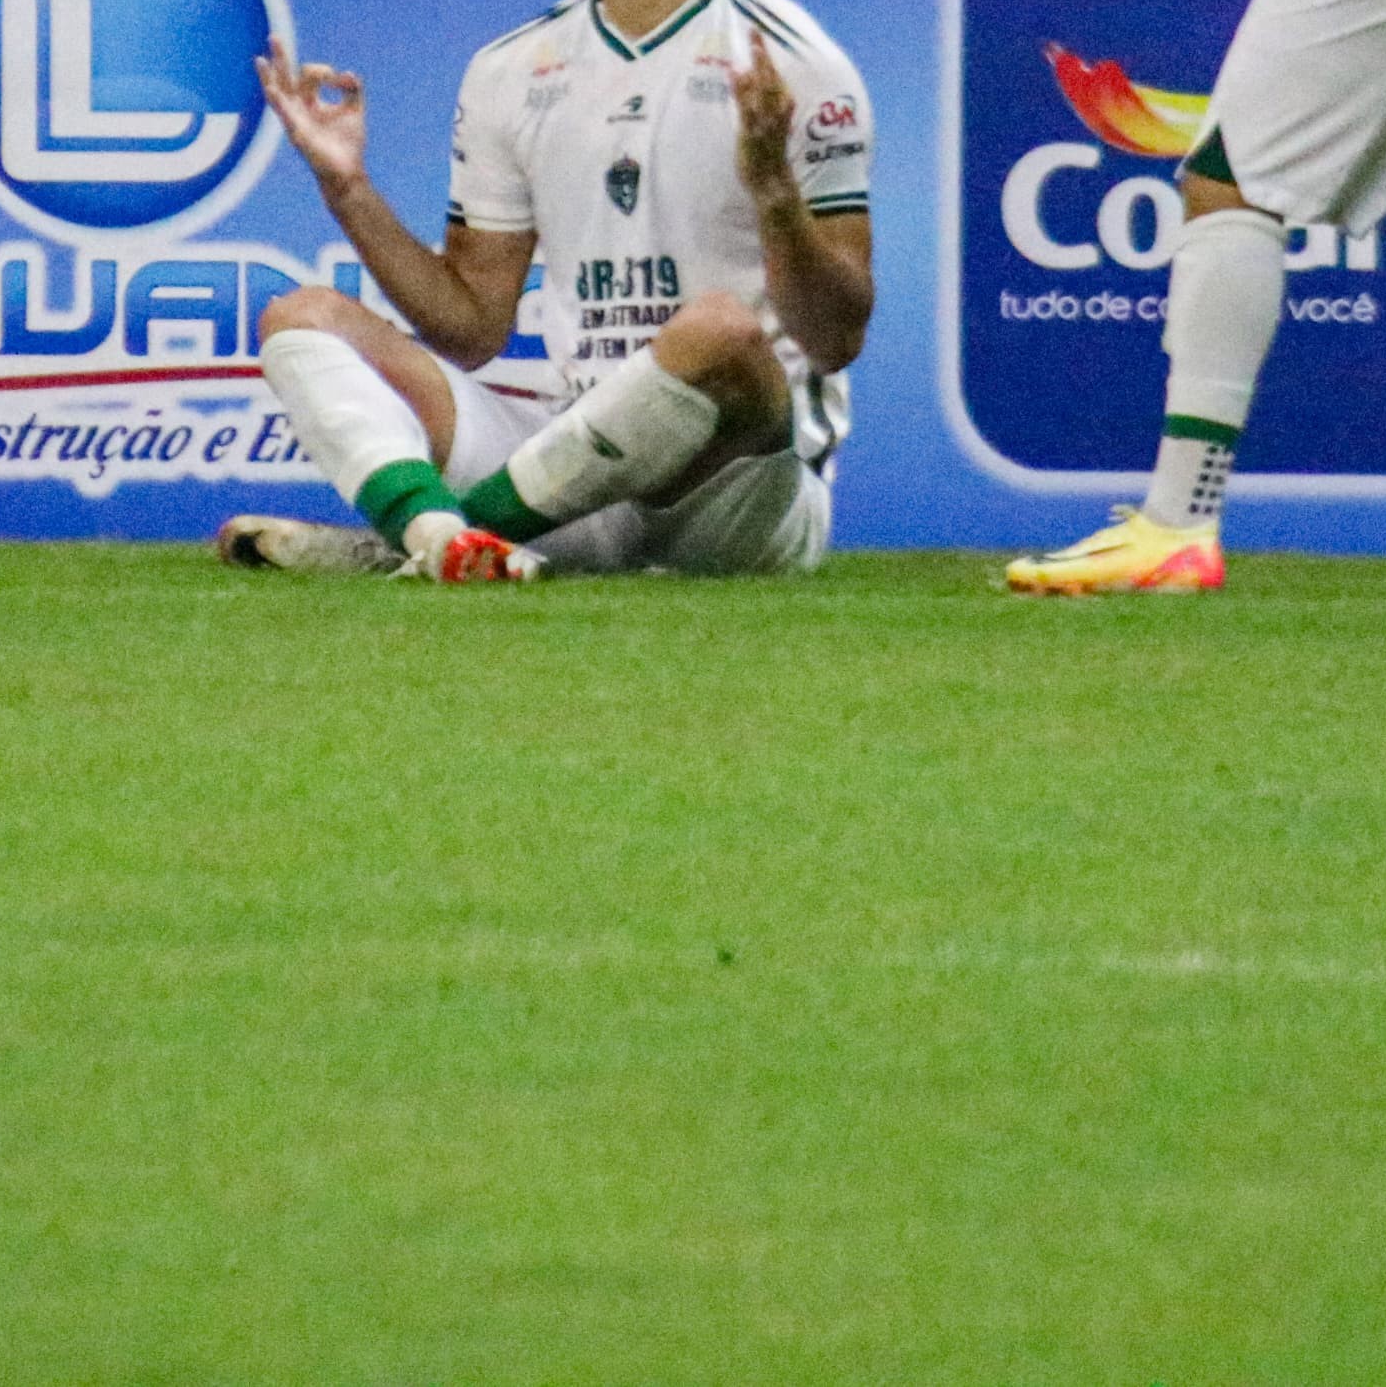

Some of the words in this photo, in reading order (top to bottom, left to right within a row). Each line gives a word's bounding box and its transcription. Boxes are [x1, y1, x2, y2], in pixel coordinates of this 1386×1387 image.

[1000, 289, 1079, 320] tudo
[1084, 289, 1131, 320] de
[1288, 292, 1378, 323] você
[201, 424, 239, 464] e
